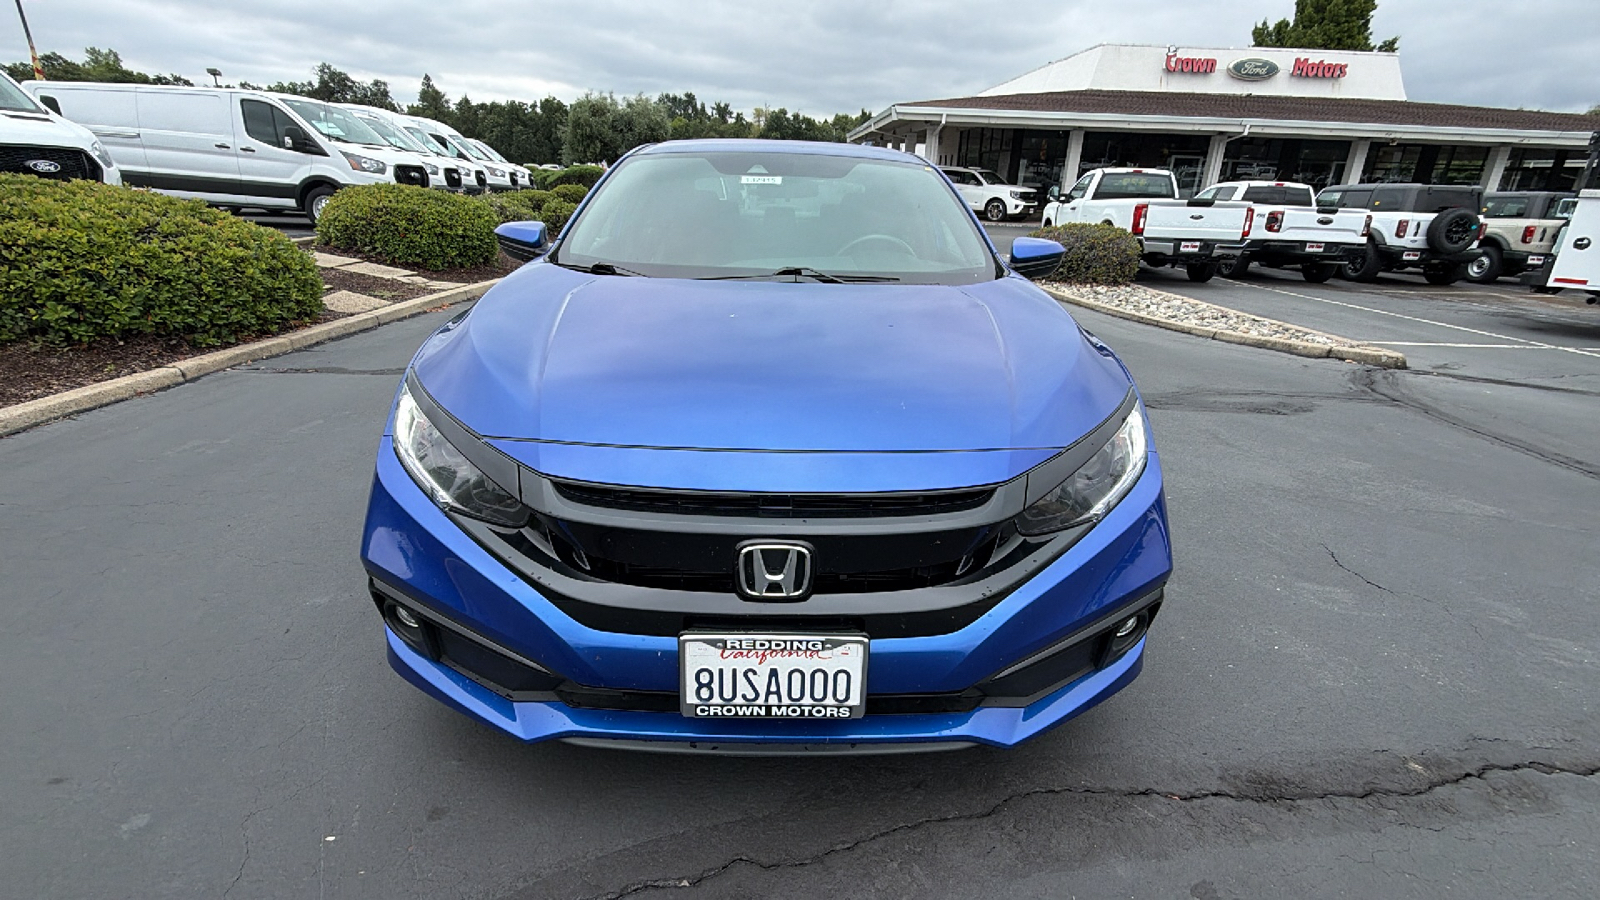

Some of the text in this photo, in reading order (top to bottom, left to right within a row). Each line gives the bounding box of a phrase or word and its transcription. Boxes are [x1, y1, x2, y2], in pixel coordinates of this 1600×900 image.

[1165, 53, 1348, 78] Crown Ford Motors
[726, 640, 823, 650] REDDING
[720, 649, 833, 665] California
[694, 667, 852, 704] 8USA000
[696, 706, 851, 717] CROWN MOTORS
